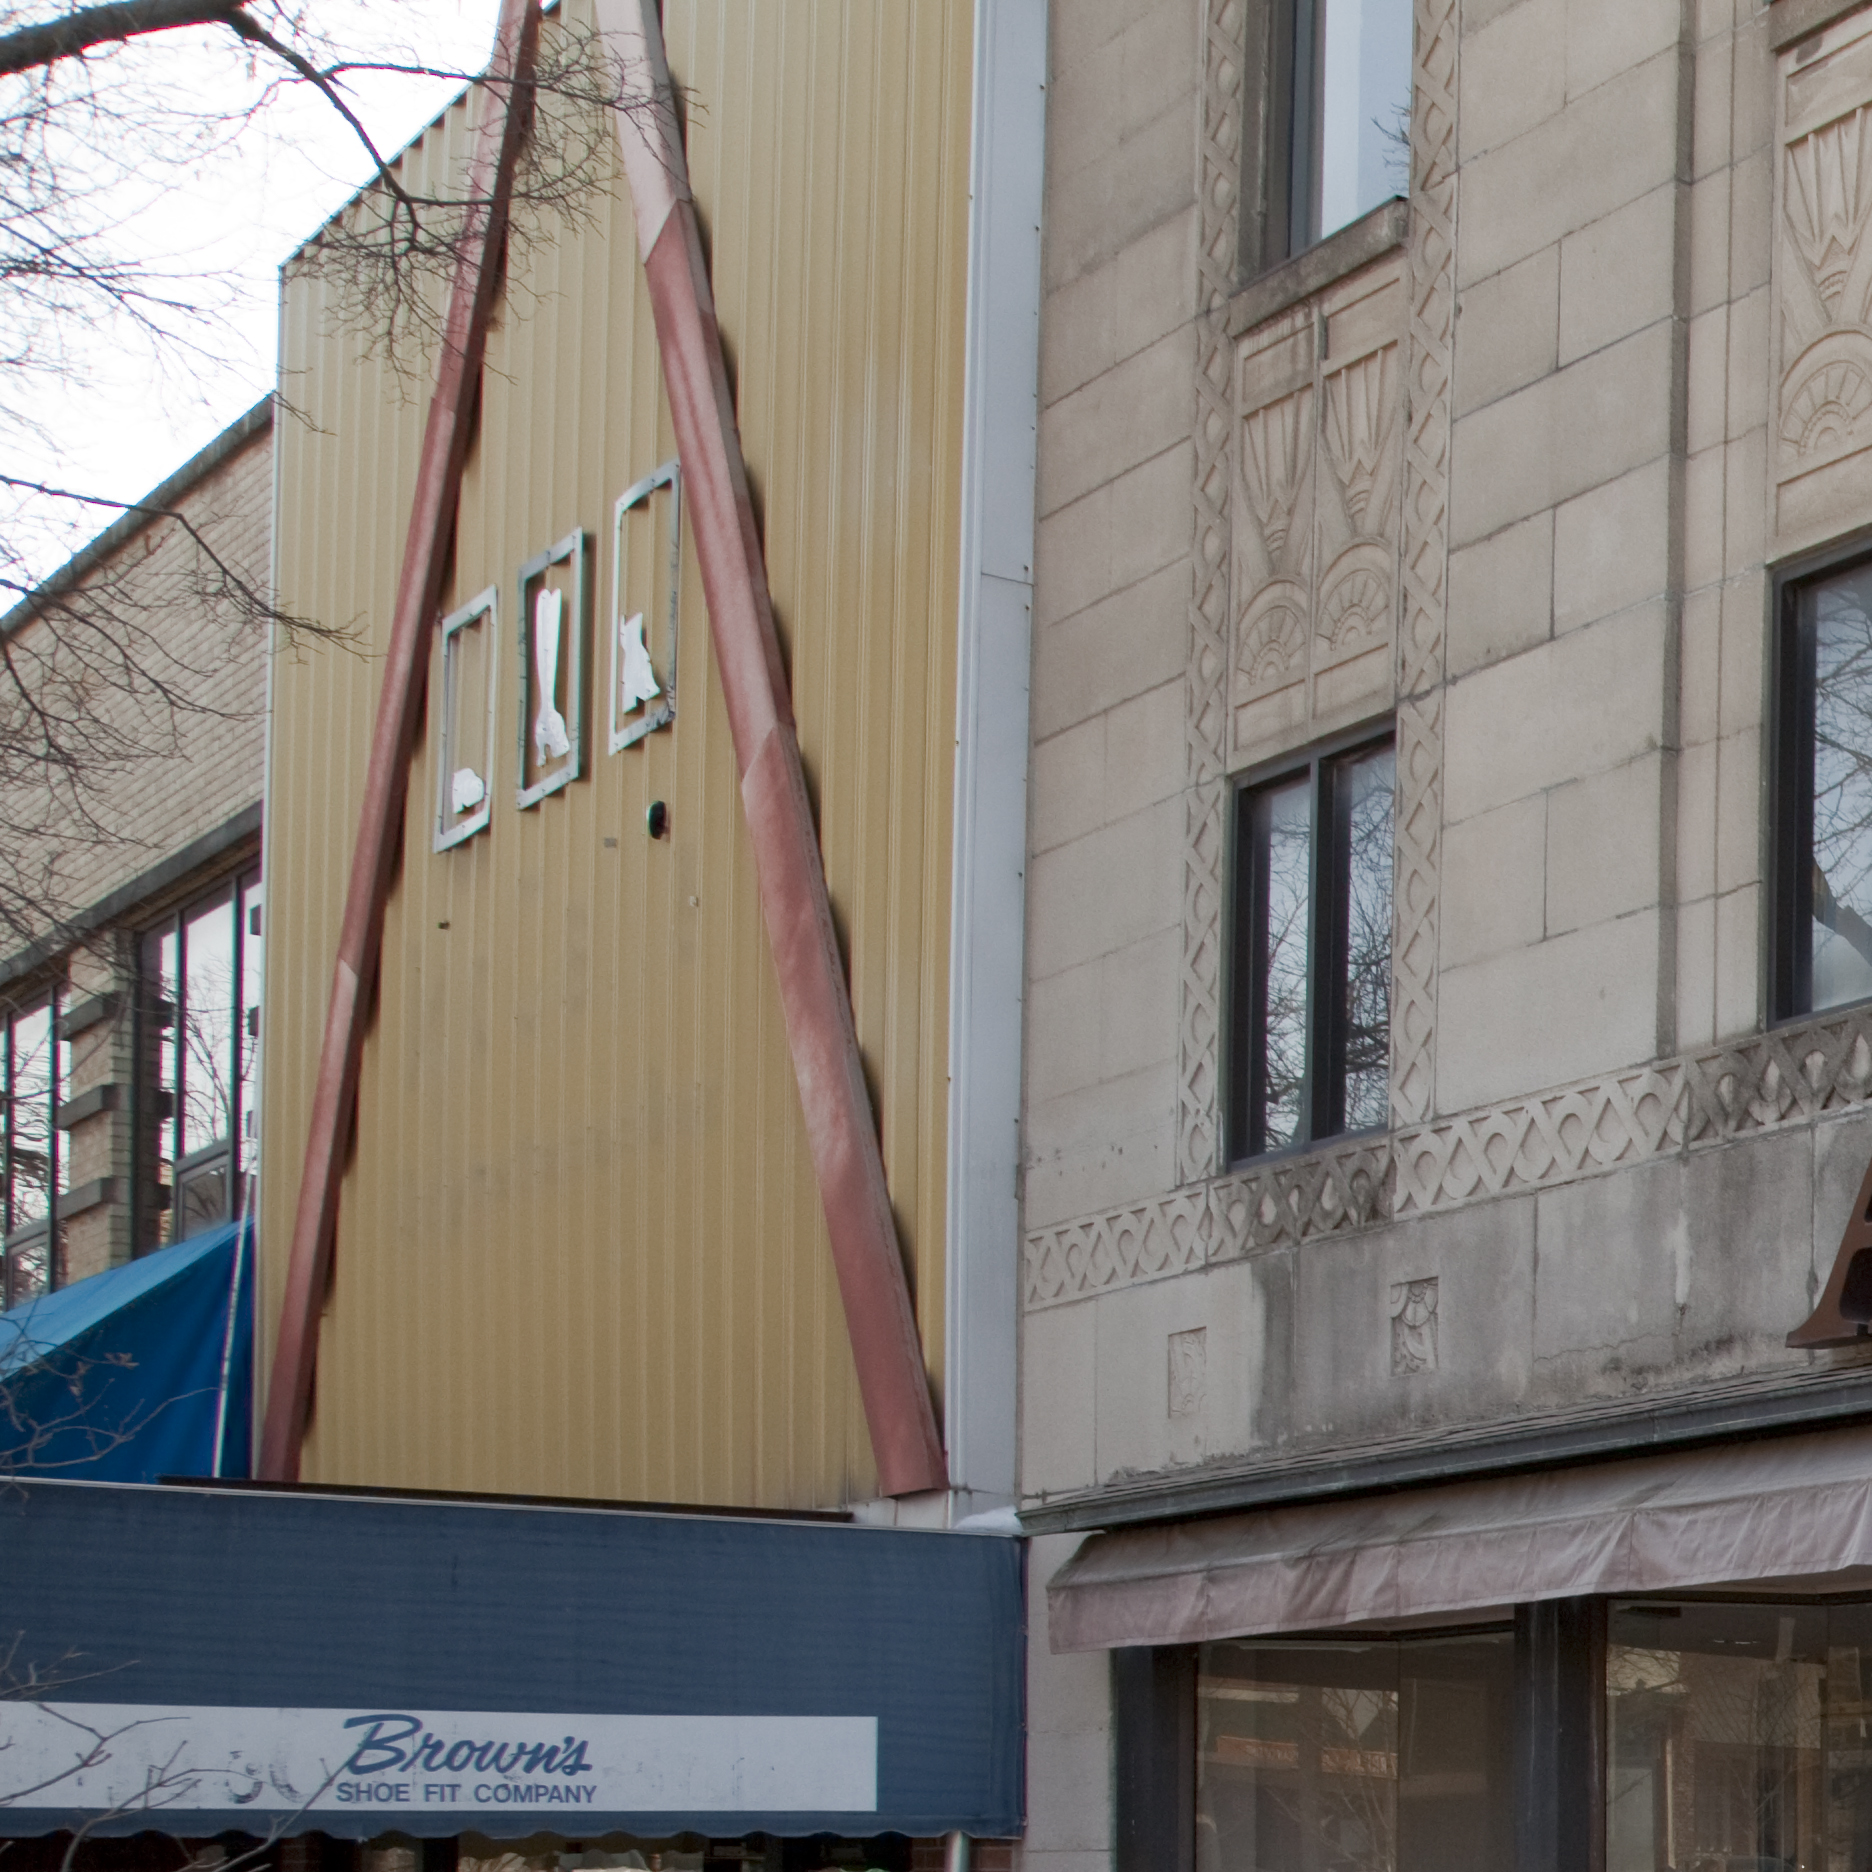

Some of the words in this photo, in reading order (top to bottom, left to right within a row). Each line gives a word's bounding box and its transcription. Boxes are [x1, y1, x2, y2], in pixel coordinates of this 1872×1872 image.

[343, 1713, 593, 1776] Brown's
[336, 1782, 410, 1803] SHOE
[424, 1783, 460, 1803] FIT
[473, 1783, 597, 1804] COMPANY
